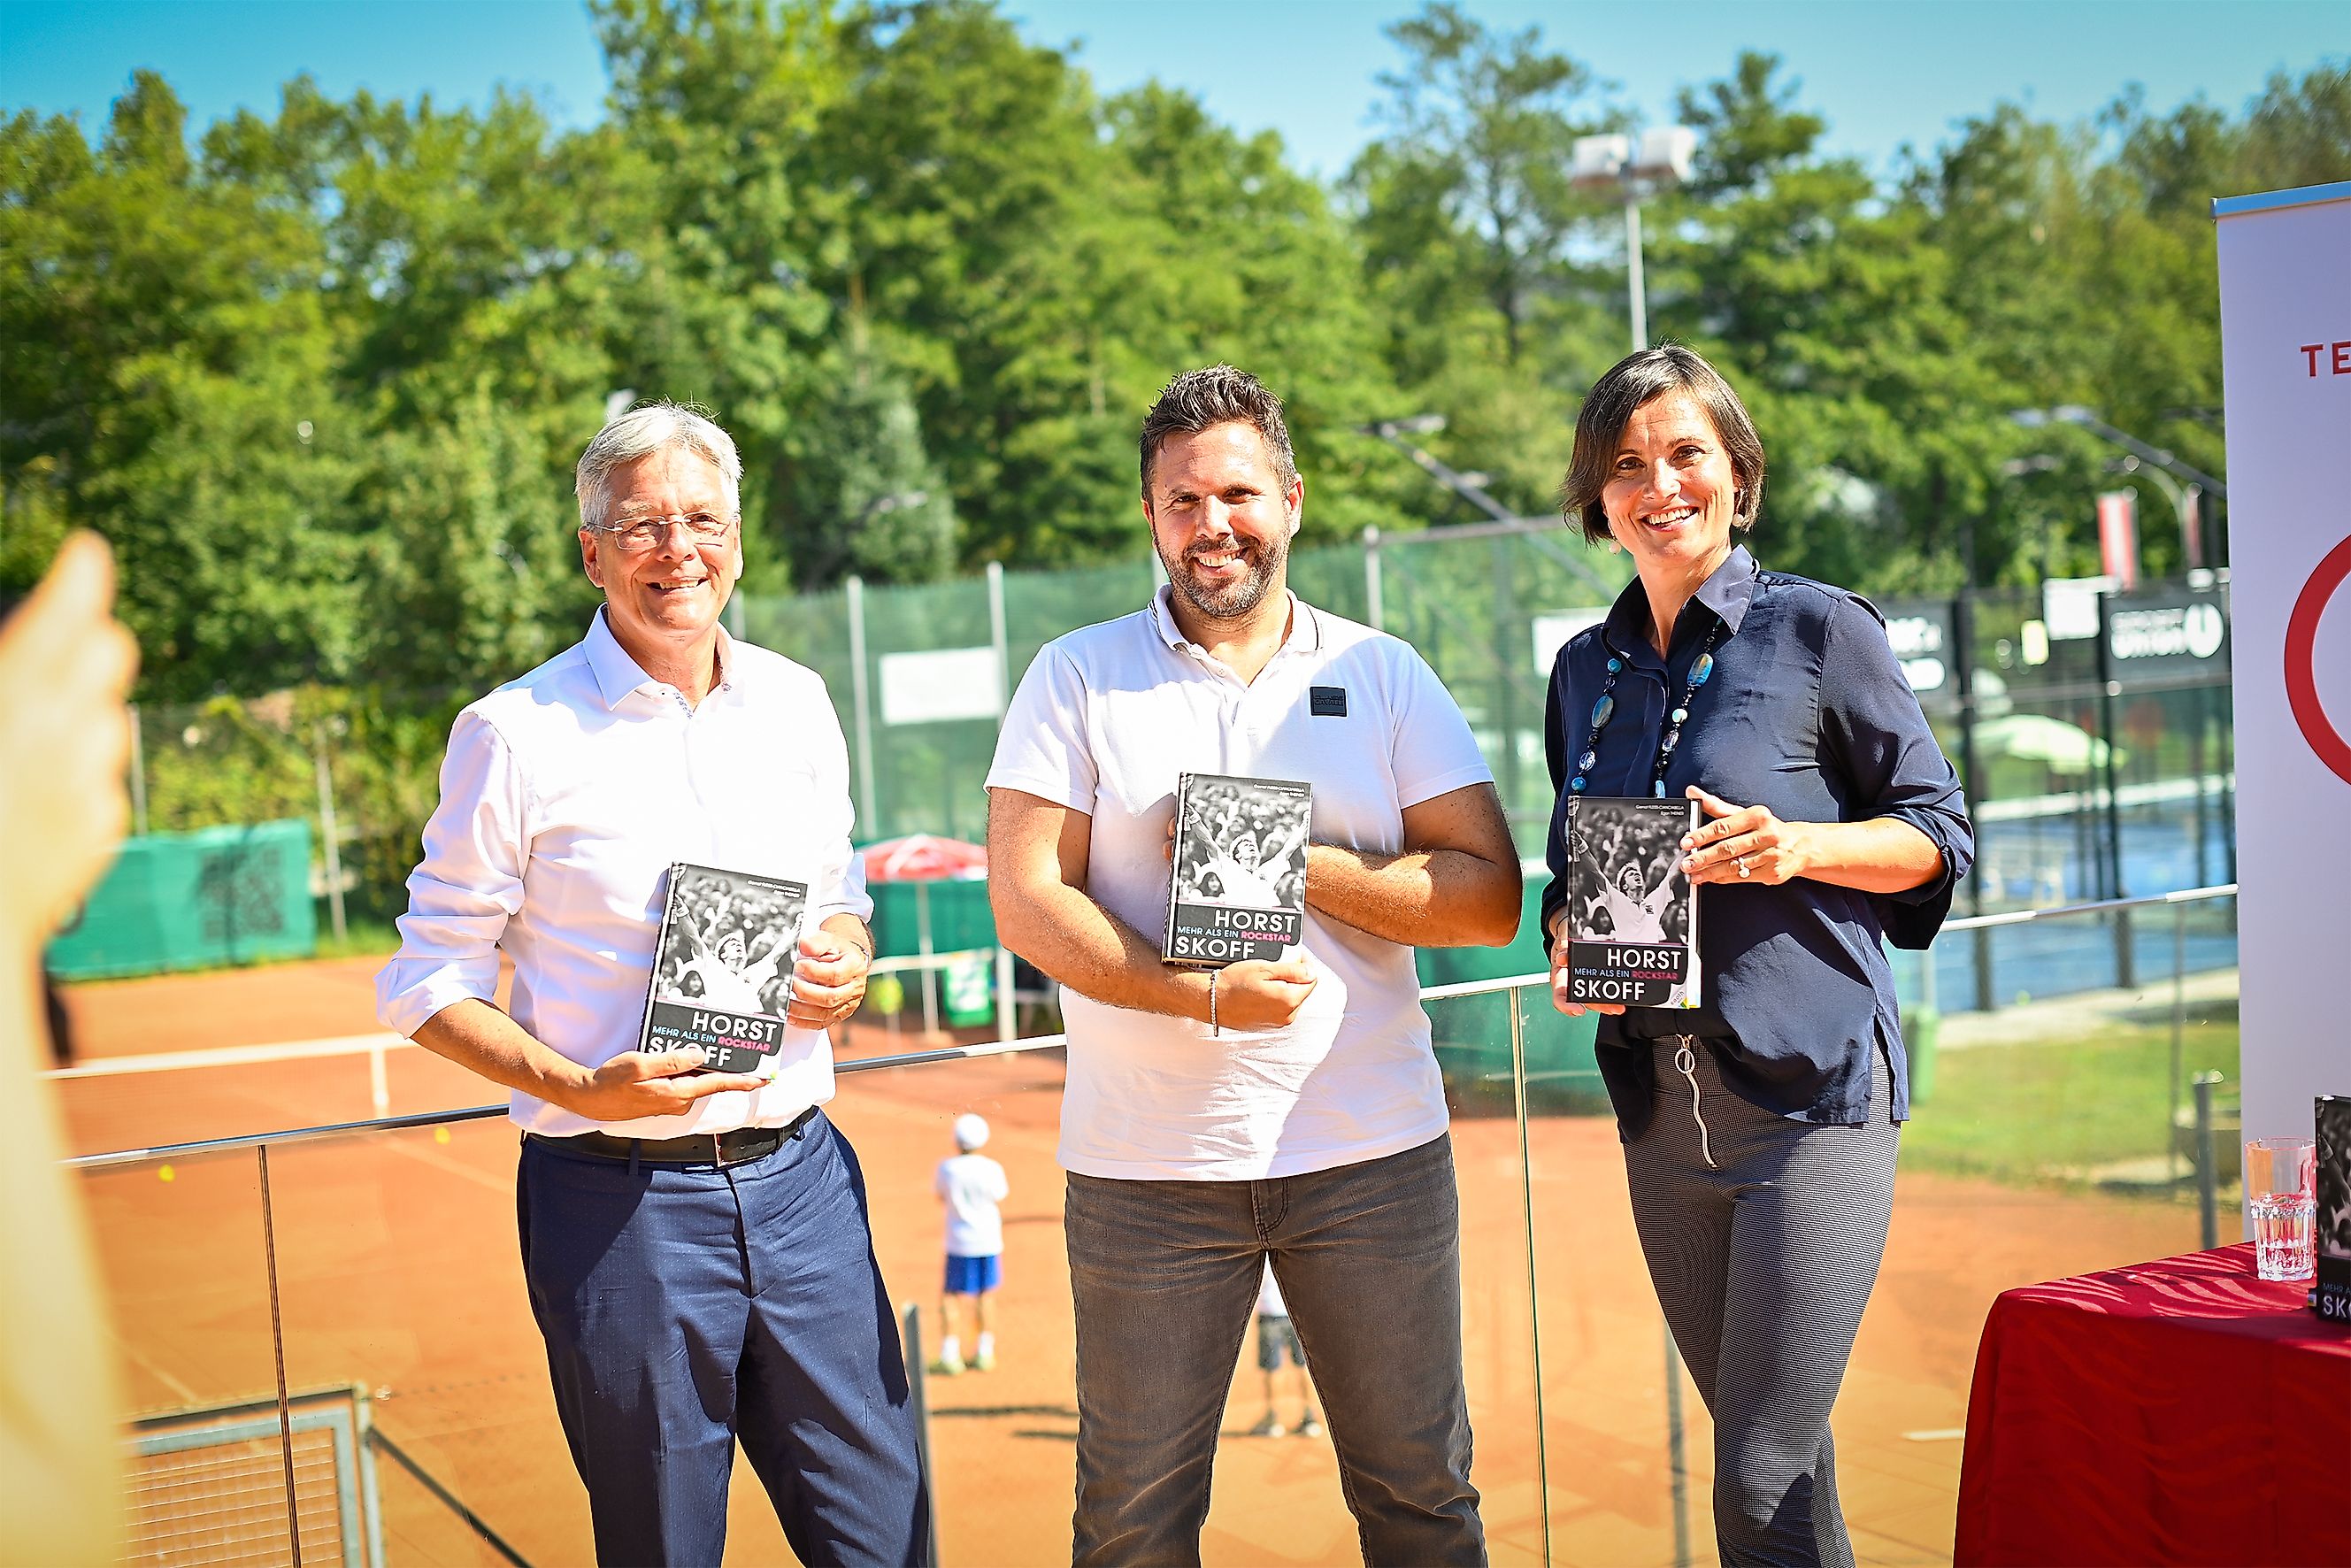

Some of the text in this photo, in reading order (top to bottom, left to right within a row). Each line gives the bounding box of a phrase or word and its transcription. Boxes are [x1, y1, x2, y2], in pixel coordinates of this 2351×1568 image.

[1214, 909, 1296, 934] HORST
[1177, 926, 1292, 942] MEHR ALS EIN ROCKSTAR
[1175, 935, 1256, 959] SKOFF
[1607, 948, 1682, 970] HORST
[1574, 967, 1597, 976] MEHR
[1631, 970, 1679, 980] ROCKSTAR
[1573, 978, 1645, 1001] SKOFF
[691, 1011, 778, 1042] HORST
[651, 1025, 771, 1052] MEHR ALS EIN ROCKSTAR
[648, 1036, 734, 1067] SKFF
[2323, 1282, 2344, 1293] MEHR
[2323, 1295, 2351, 1318] SK
